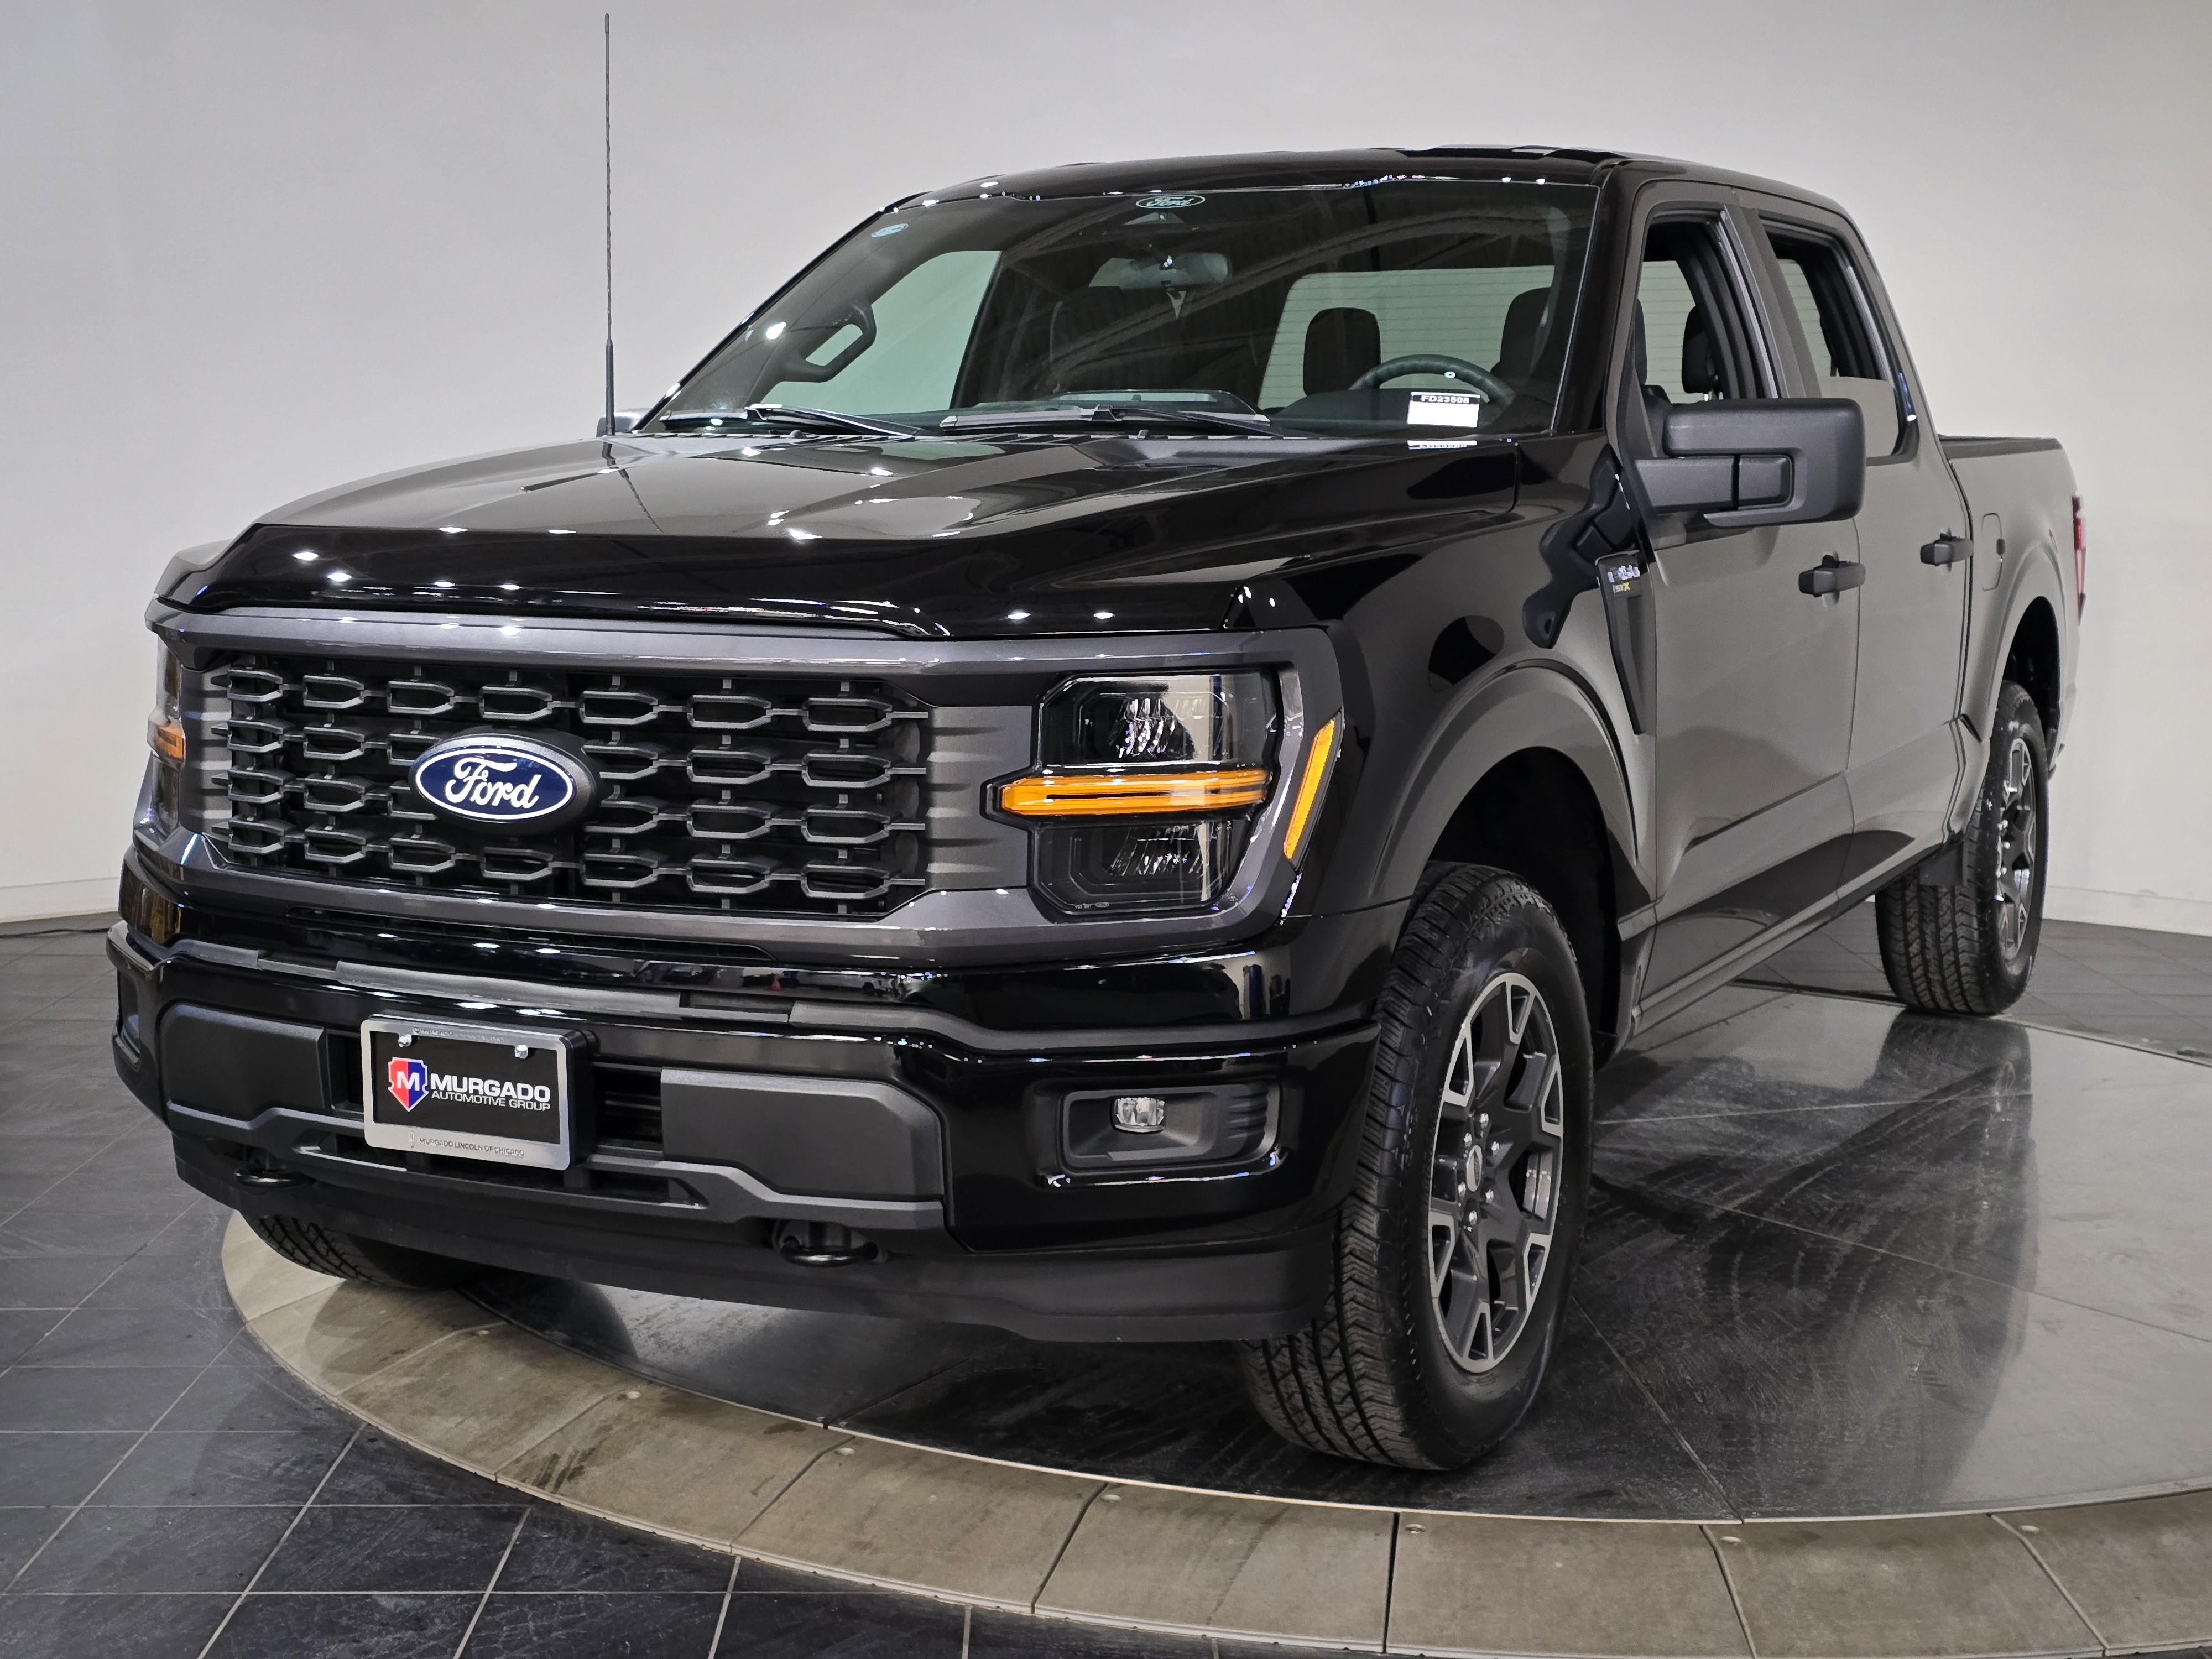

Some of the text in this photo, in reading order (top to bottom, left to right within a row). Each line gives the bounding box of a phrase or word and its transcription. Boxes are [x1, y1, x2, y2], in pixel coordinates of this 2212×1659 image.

[1146, 196, 1195, 206] Ford
[1421, 395, 1470, 404] FD23508
[445, 757, 542, 809] Ford
[431, 1073, 551, 1103] MURGADO
[431, 1090, 551, 1112] AUTOMOTIVE GROUP
[419, 1137, 453, 1148] MURGADO
[455, 1141, 483, 1152] LINCOLN
[494, 1146, 525, 1157] CHICAGO
